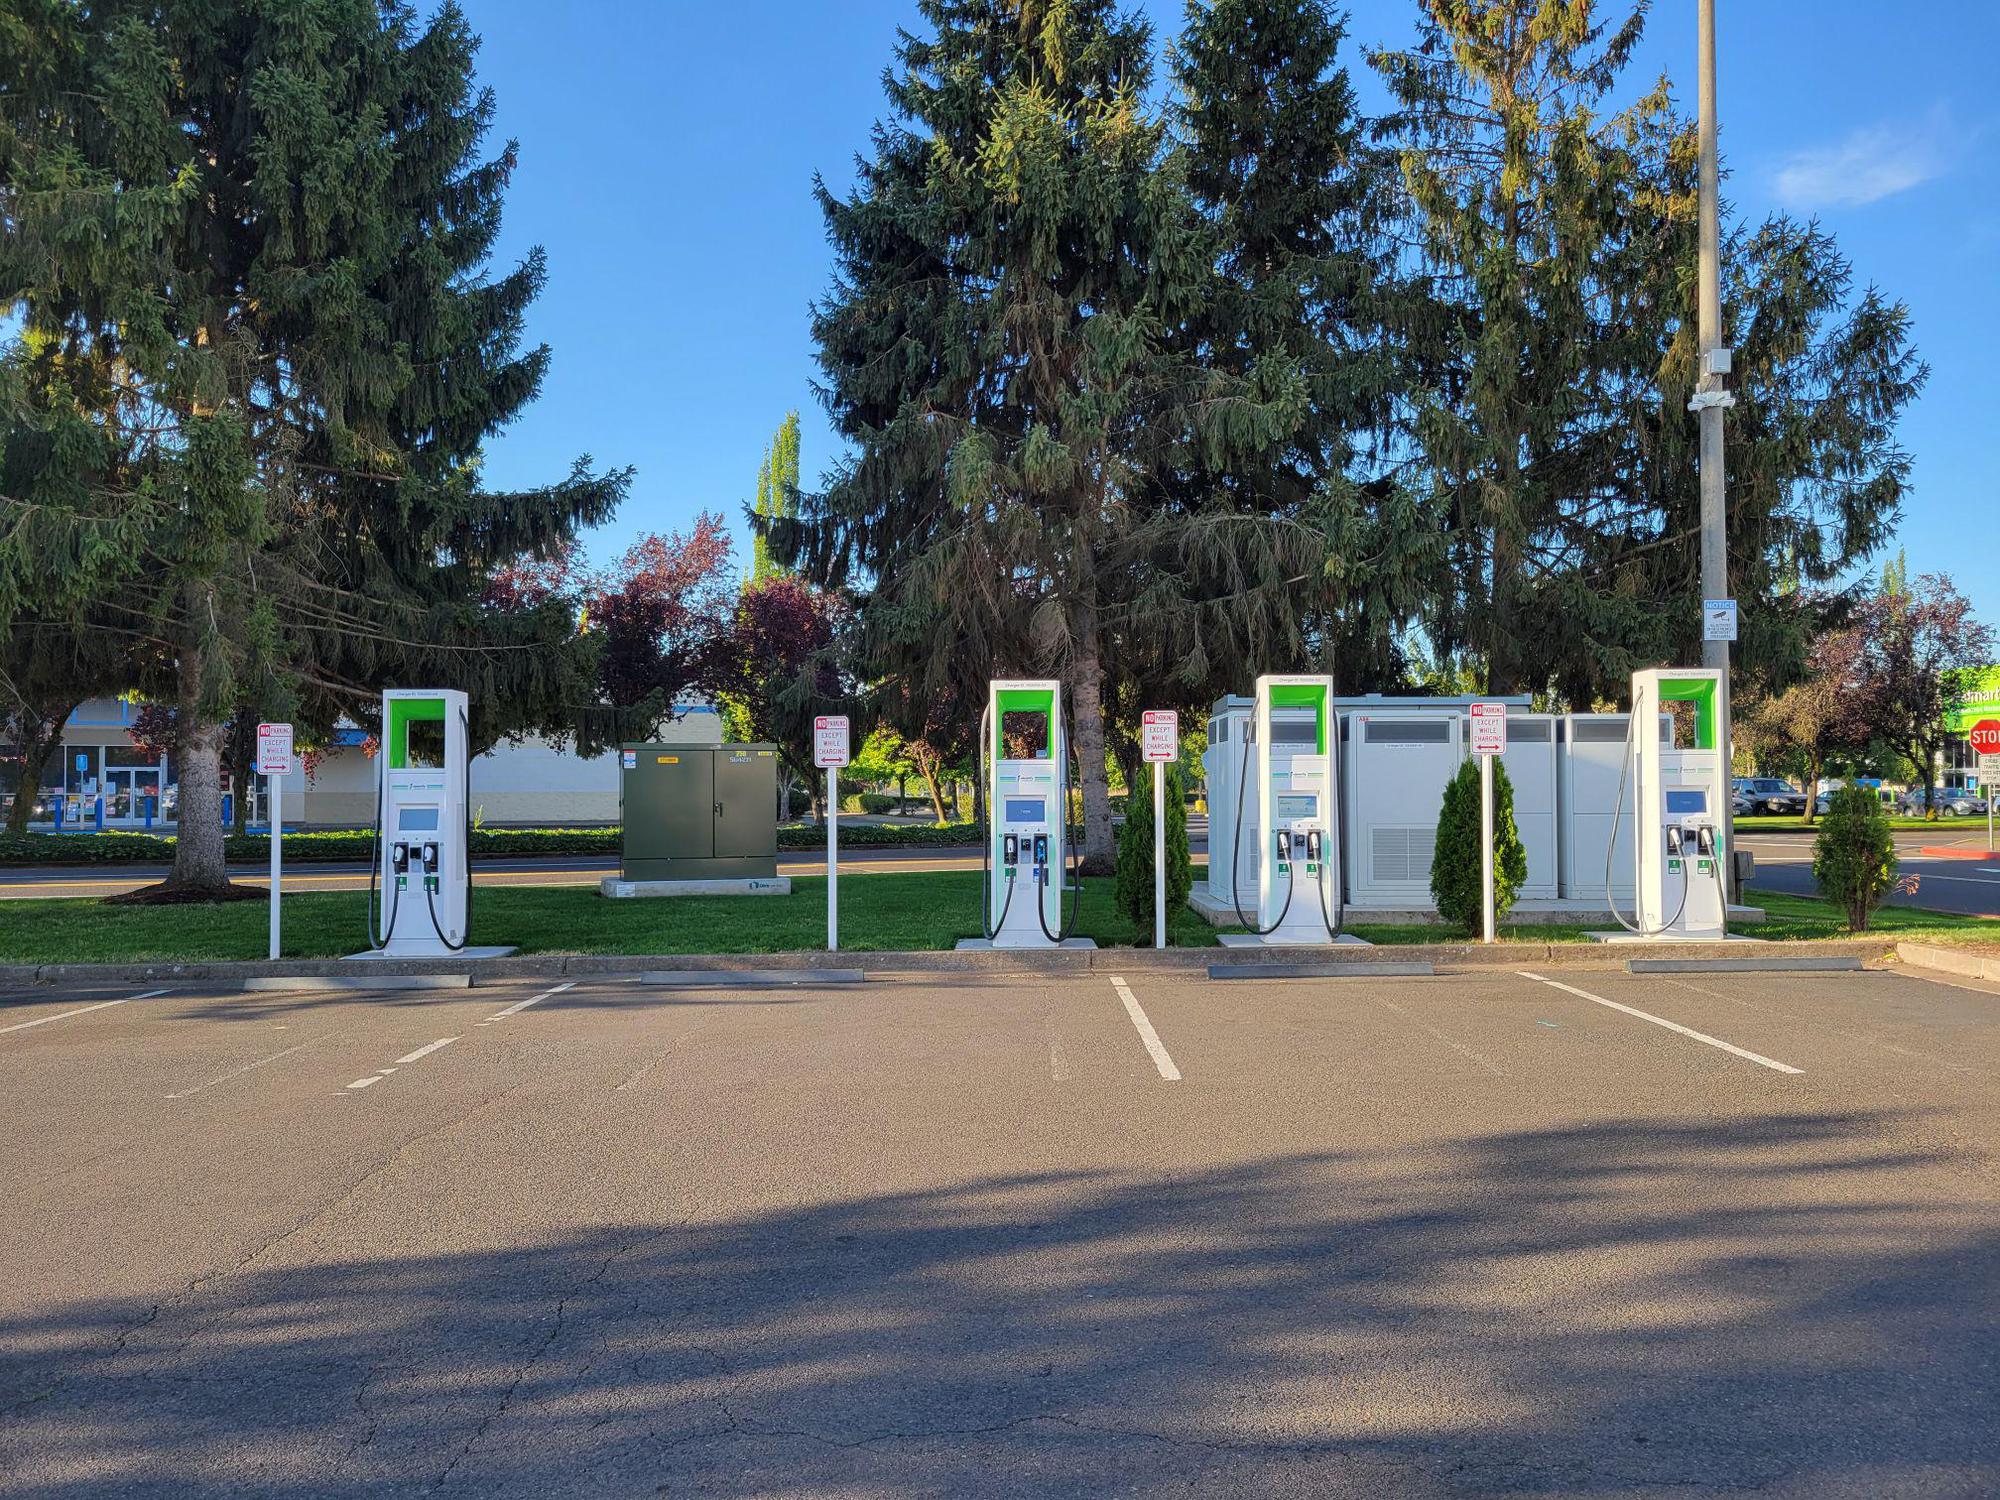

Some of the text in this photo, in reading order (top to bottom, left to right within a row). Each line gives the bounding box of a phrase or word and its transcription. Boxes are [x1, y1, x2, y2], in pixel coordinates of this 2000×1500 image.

[1145, 714, 1154, 722] NO
[260, 726, 270, 736] NO
[1972, 730, 2000, 744] STO
